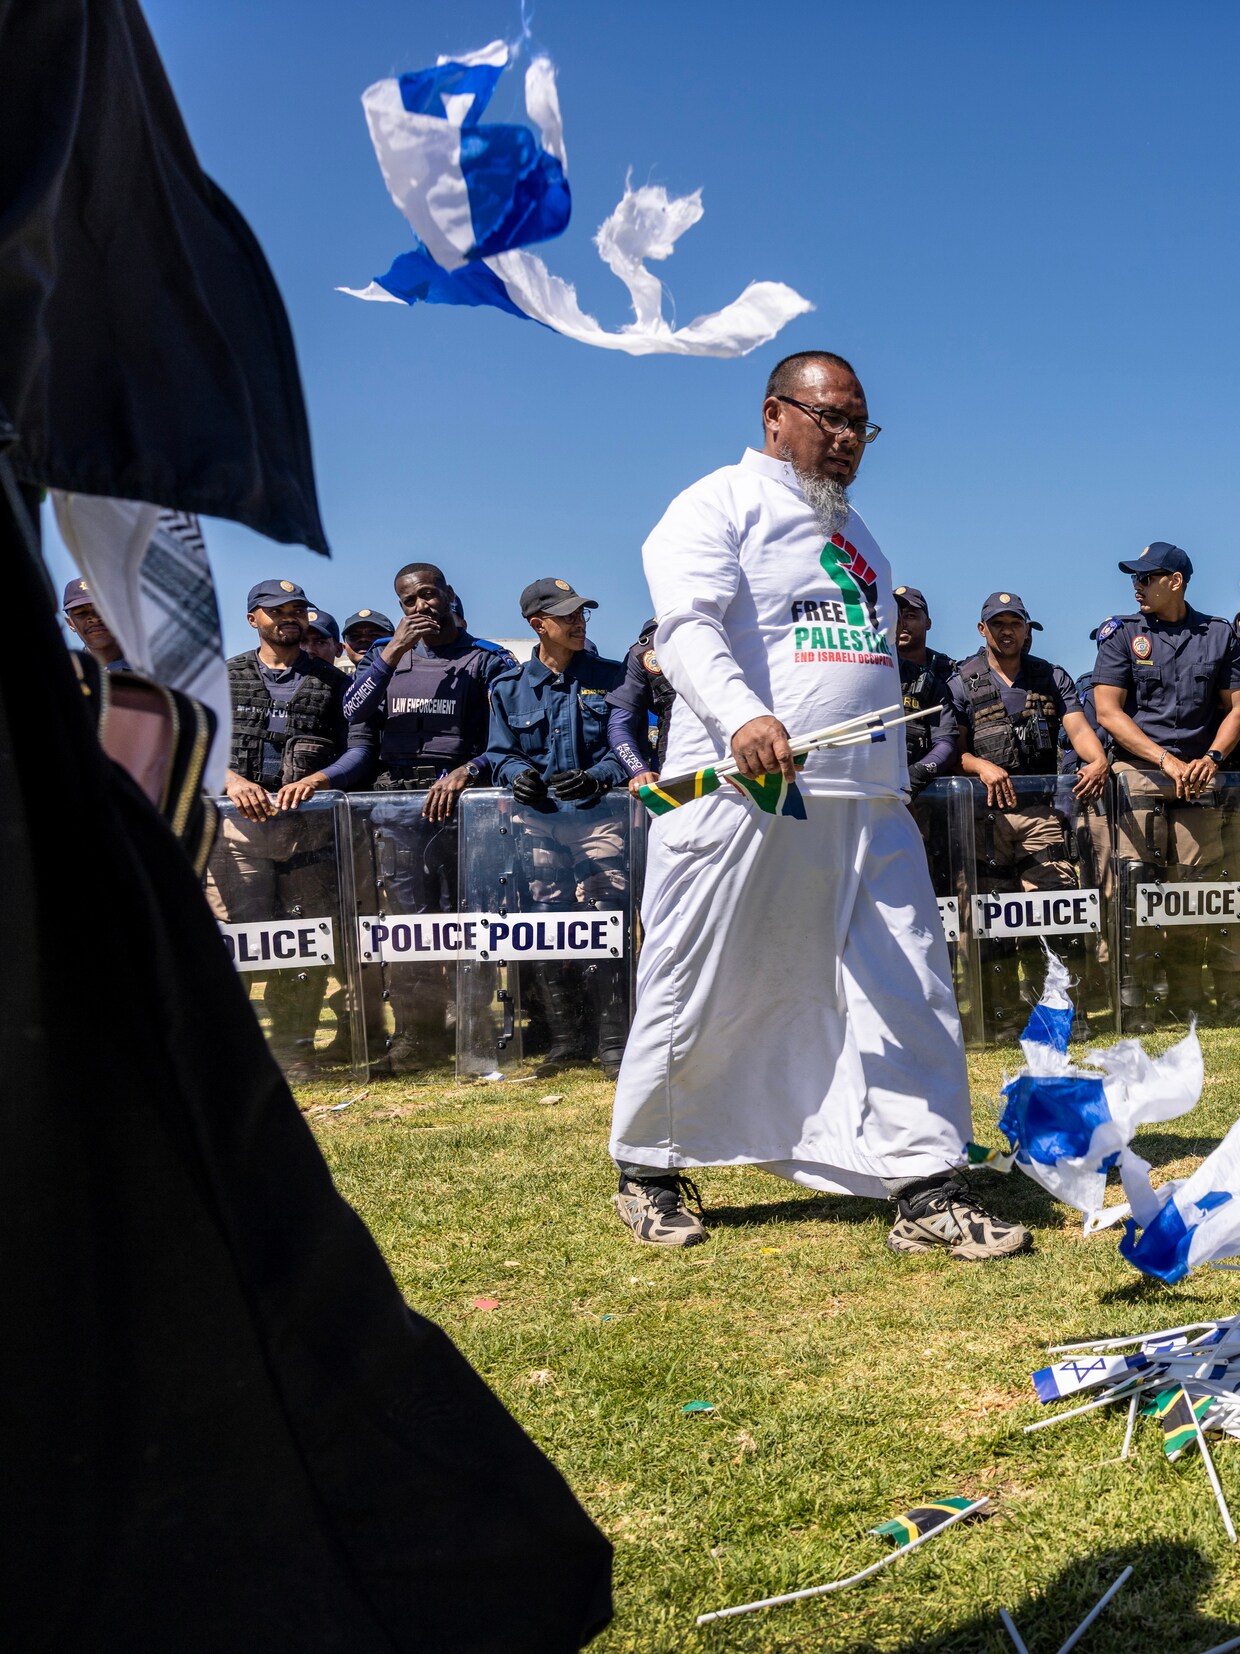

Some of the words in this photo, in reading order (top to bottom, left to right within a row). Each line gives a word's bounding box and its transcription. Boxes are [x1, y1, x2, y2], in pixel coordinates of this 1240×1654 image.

[791, 600, 846, 623] FREE
[794, 651, 815, 663] END
[818, 651, 857, 663] ISRAELI
[343, 676, 377, 719] FORCEMENT
[392, 697, 407, 713] LAW
[407, 697, 457, 715] ENFORCEMENT
[616, 745, 638, 772] POLICE
[621, 743, 643, 768] METRO
[983, 897, 1088, 929] POLICE
[1147, 889, 1235, 917] POLICE
[371, 922, 476, 953] POLICE
[489, 921, 608, 951] POLICE
